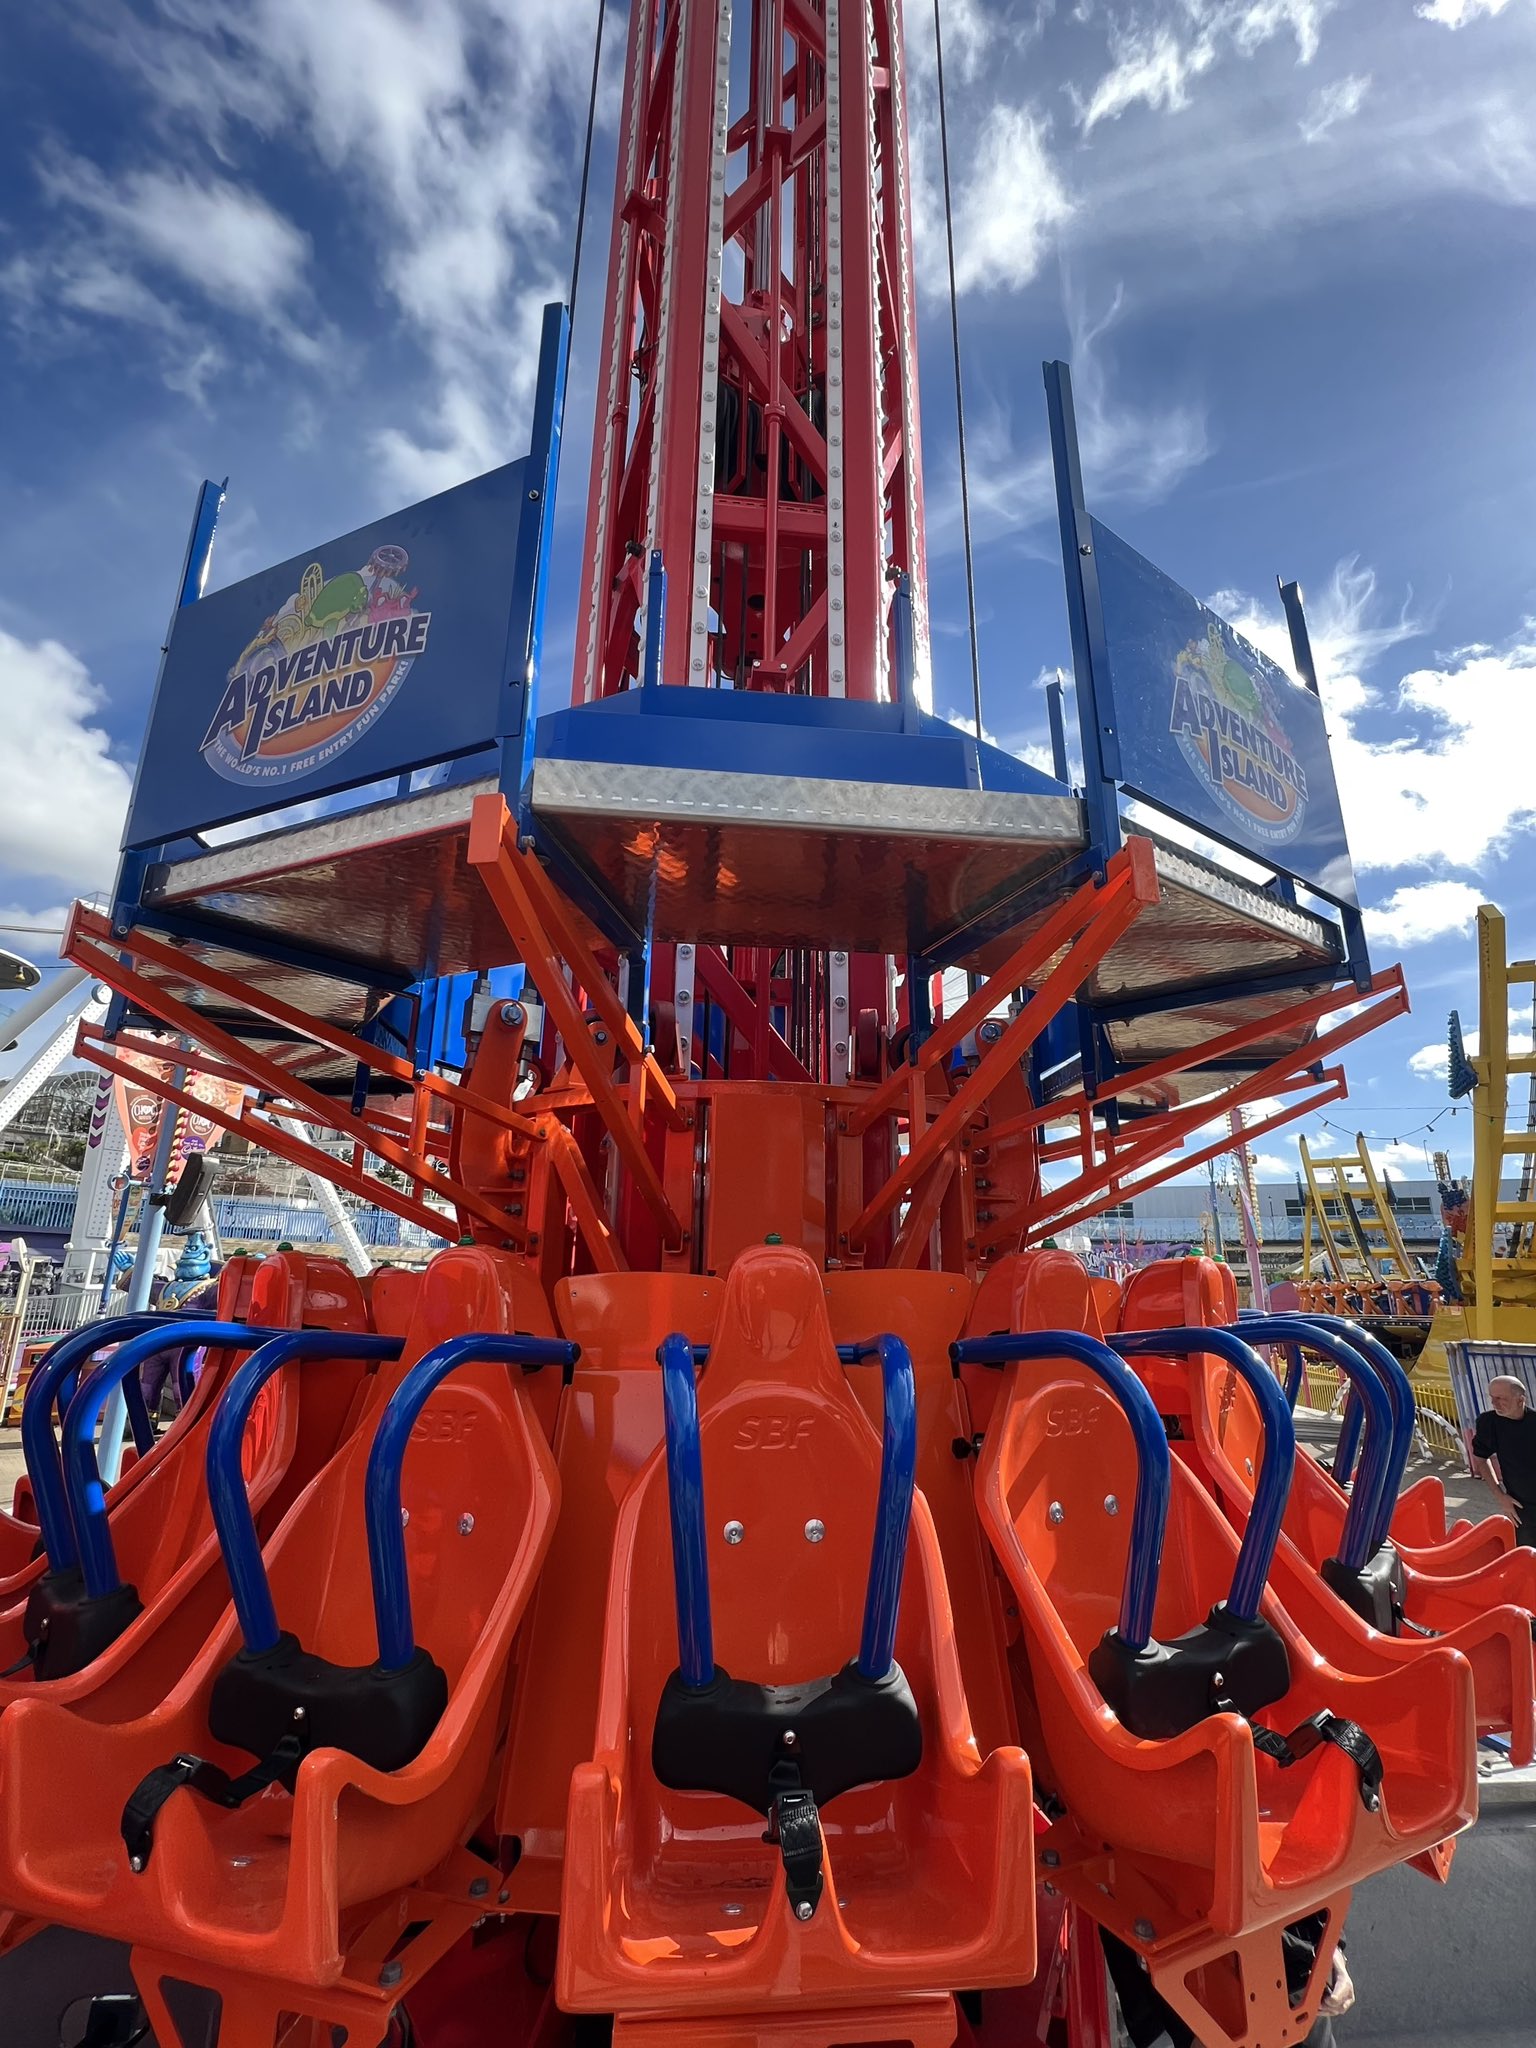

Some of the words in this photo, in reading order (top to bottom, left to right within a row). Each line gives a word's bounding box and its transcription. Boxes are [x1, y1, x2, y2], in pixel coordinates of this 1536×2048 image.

[199, 612, 432, 752] ADVENTURE
[213, 740, 228, 758] THE
[290, 756, 316, 773] FREE
[318, 730, 354, 761] ENTRY
[355, 705, 381, 732] FUN
[380, 659, 410, 704] PARK!
[242, 669, 375, 762] ISLAND
[1169, 675, 1309, 802] ADVENTURE
[1207, 727, 1288, 812] ISLAND
[732, 1414, 816, 1451] SBF
